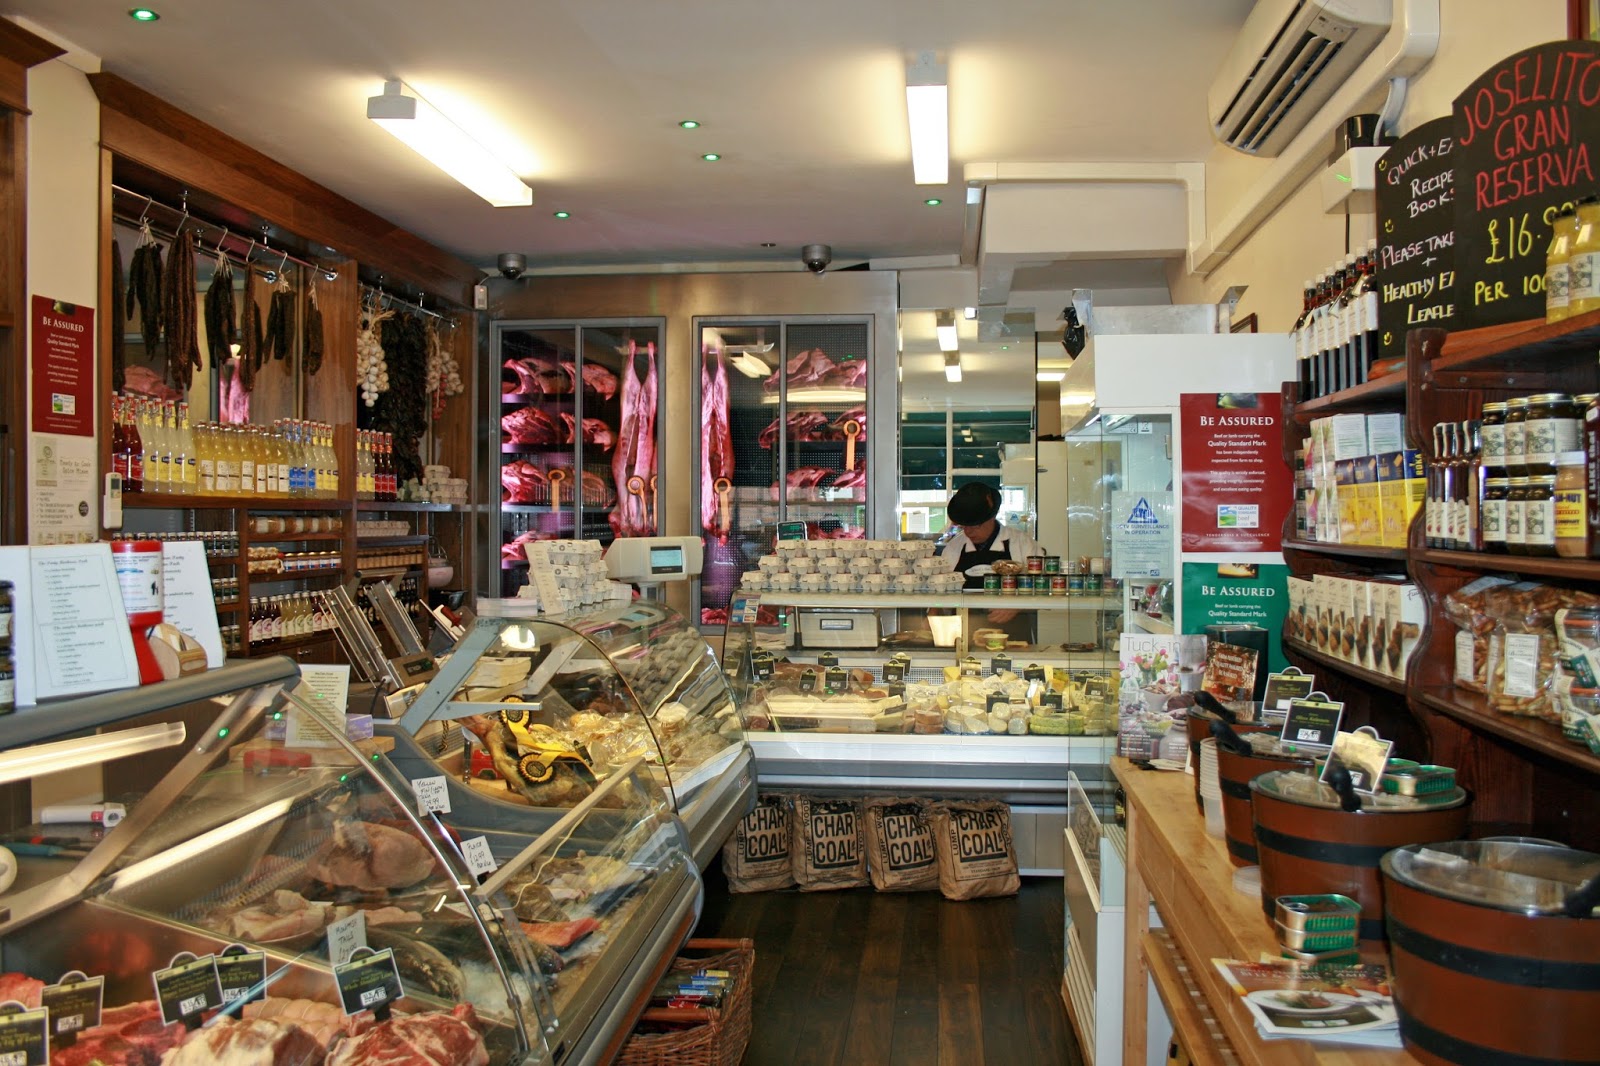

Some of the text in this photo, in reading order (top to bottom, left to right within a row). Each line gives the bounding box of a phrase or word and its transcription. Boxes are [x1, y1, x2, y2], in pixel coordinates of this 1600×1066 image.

[1460, 52, 1600, 146] JOSELITO
[1494, 105, 1571, 161] GRAN
[1387, 145, 1429, 186] QUICK
[1476, 142, 1594, 212] RESERVA
[1410, 169, 1454, 199] RECIPE
[1380, 240, 1424, 270] PLEASE
[1383, 276, 1435, 304] HEALTHY
[1475, 280, 1509, 306] PER
[53, 318, 84, 333] ASSURED
[1200, 415, 1274, 426] BE ASSURED
[1414, 454, 1424, 476] ROKA
[1202, 585, 1276, 597] BE ASSURED
[747, 806, 785, 832] CHAR
[814, 813, 854, 838] CHAR
[960, 811, 998, 832] CHAR
[748, 832, 786, 857] COAL
[816, 839, 855, 864] COAL
[890, 838, 932, 865] COAL
[962, 830, 1003, 856] COAL
